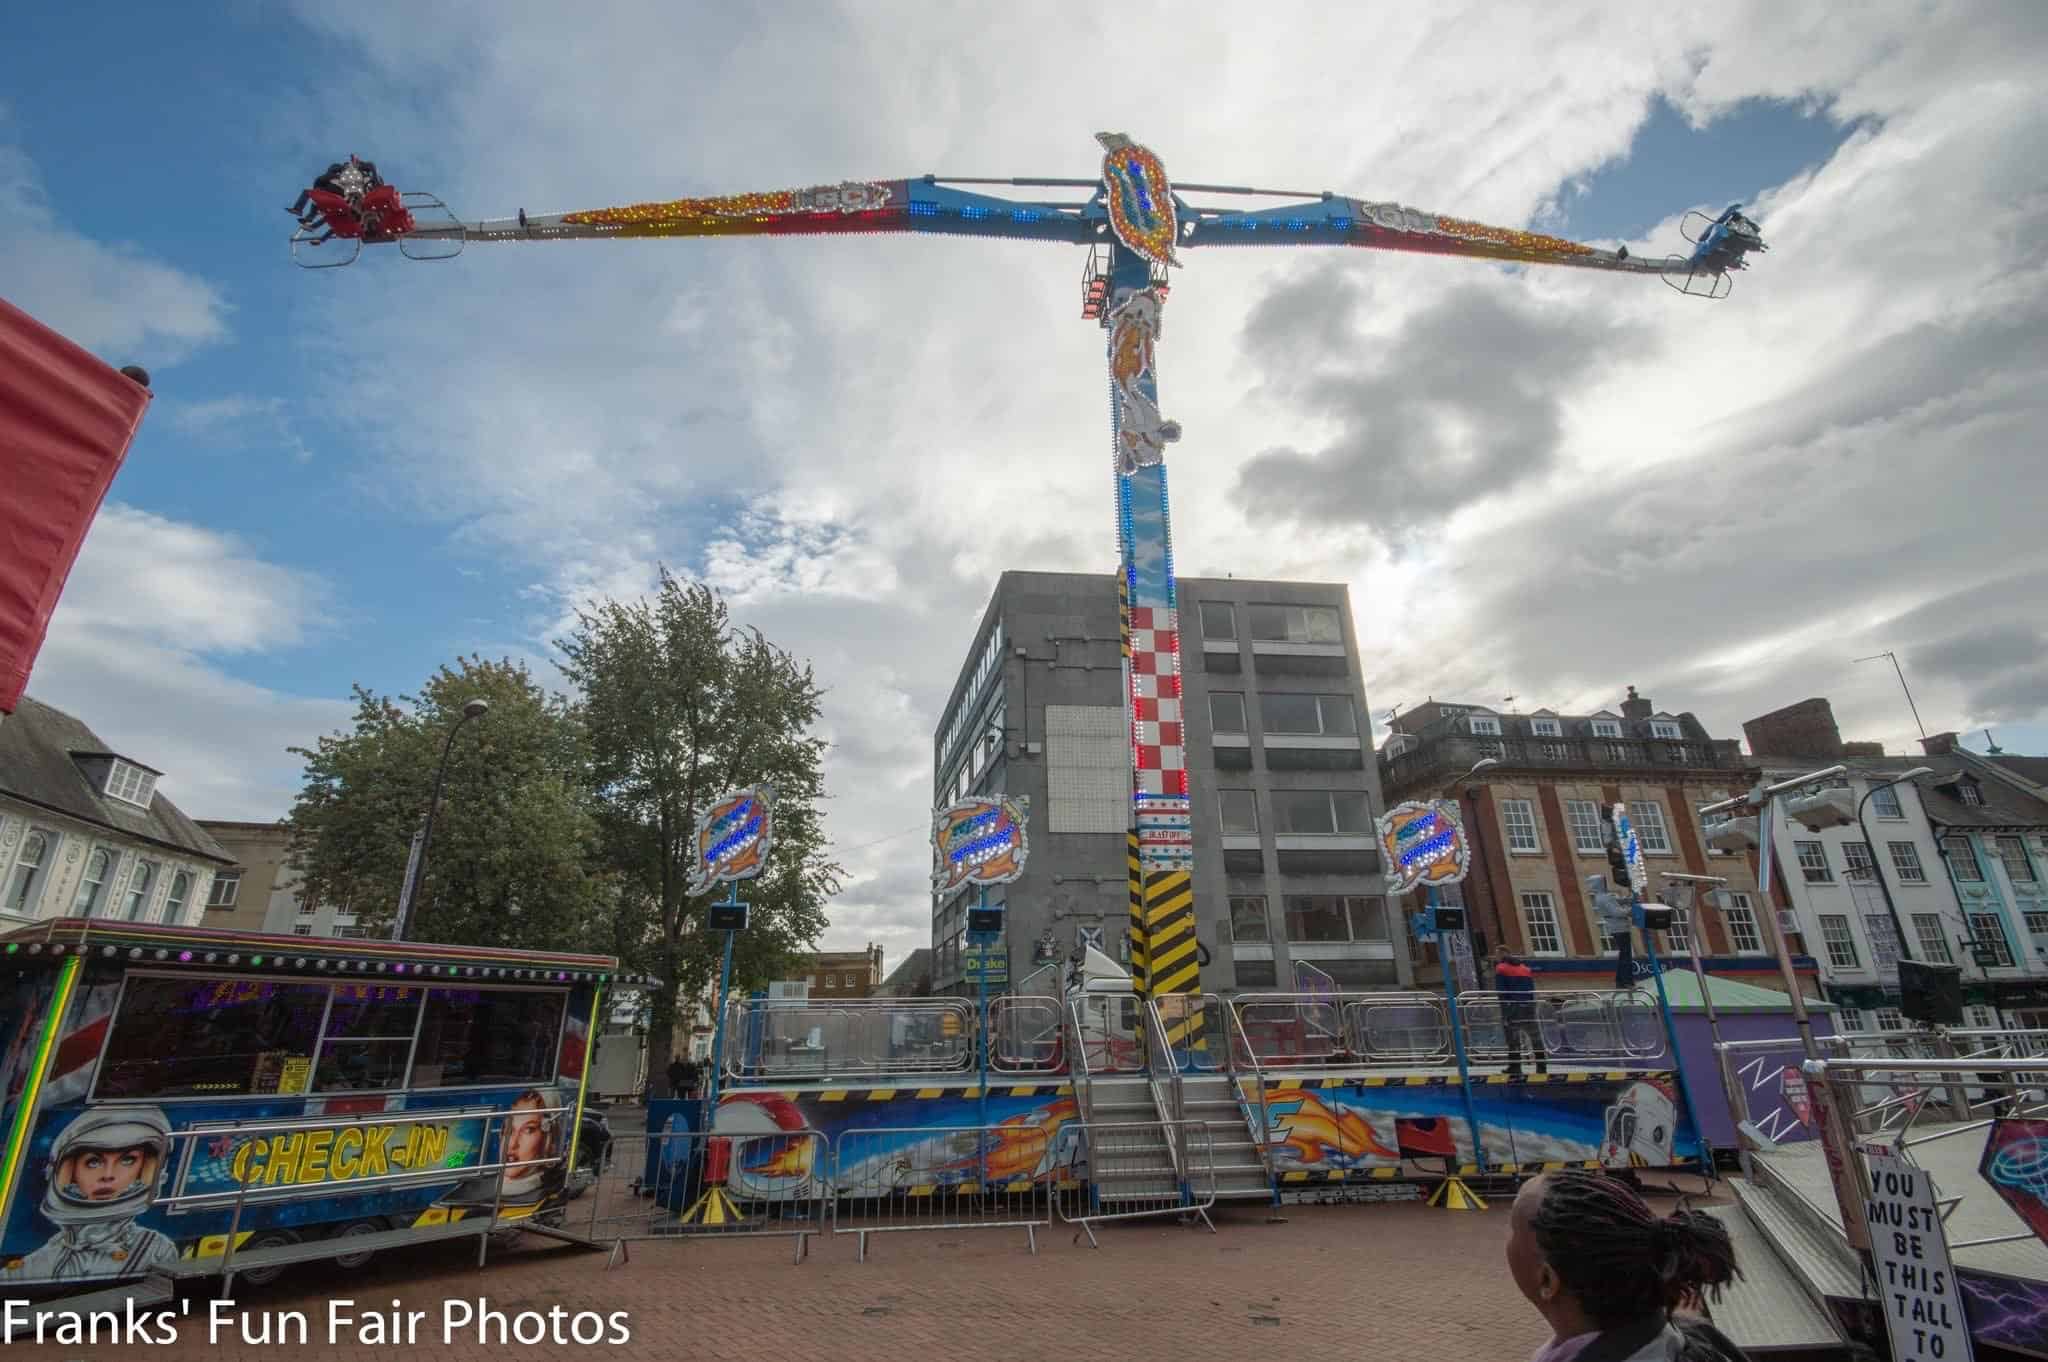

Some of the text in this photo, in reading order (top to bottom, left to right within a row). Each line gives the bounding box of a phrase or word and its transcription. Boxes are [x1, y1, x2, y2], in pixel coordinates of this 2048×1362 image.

[232, 1125, 448, 1185] CHECK-IN
[1870, 1171, 1913, 1198] YOU
[1869, 1203, 1933, 1233] MUST
[1893, 1231, 1923, 1259] BE
[1885, 1261, 1945, 1296] THIS
[1894, 1293, 1953, 1330] TALL
[1913, 1328, 1945, 1359] TO
